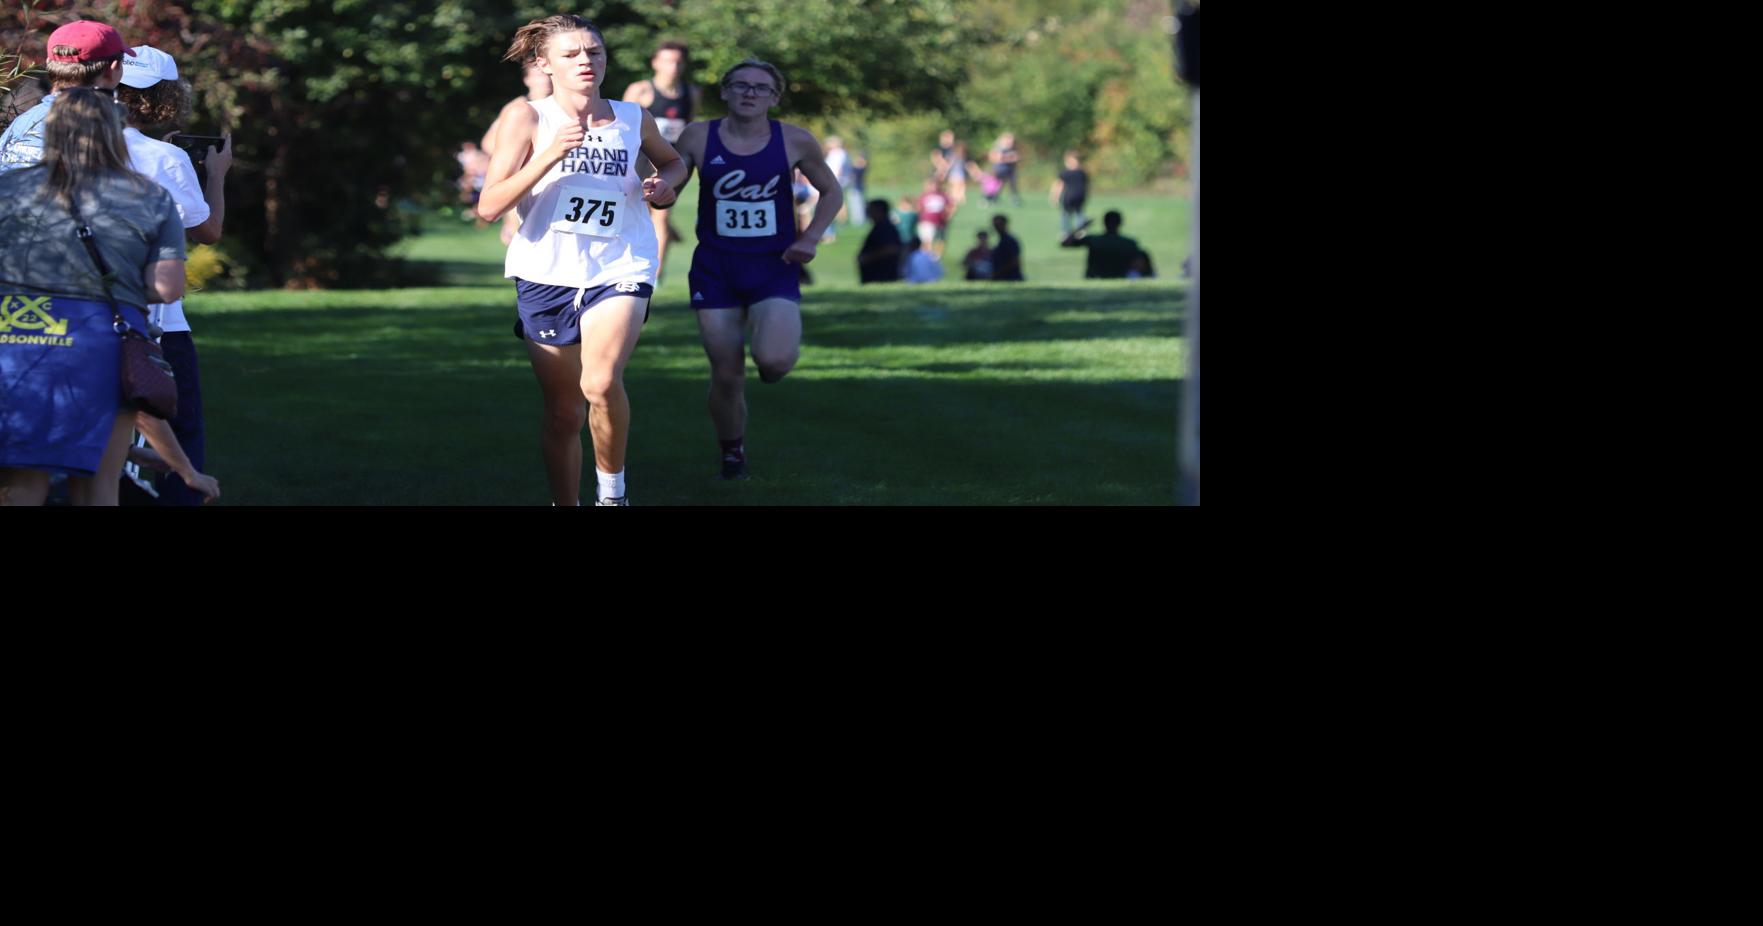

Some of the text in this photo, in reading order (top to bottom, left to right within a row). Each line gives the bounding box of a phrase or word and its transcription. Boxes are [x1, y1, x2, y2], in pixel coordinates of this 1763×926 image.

[561, 160, 628, 177] HAVEN
[713, 169, 780, 200] Cal
[565, 196, 617, 227] 375
[725, 208, 768, 229] 313
